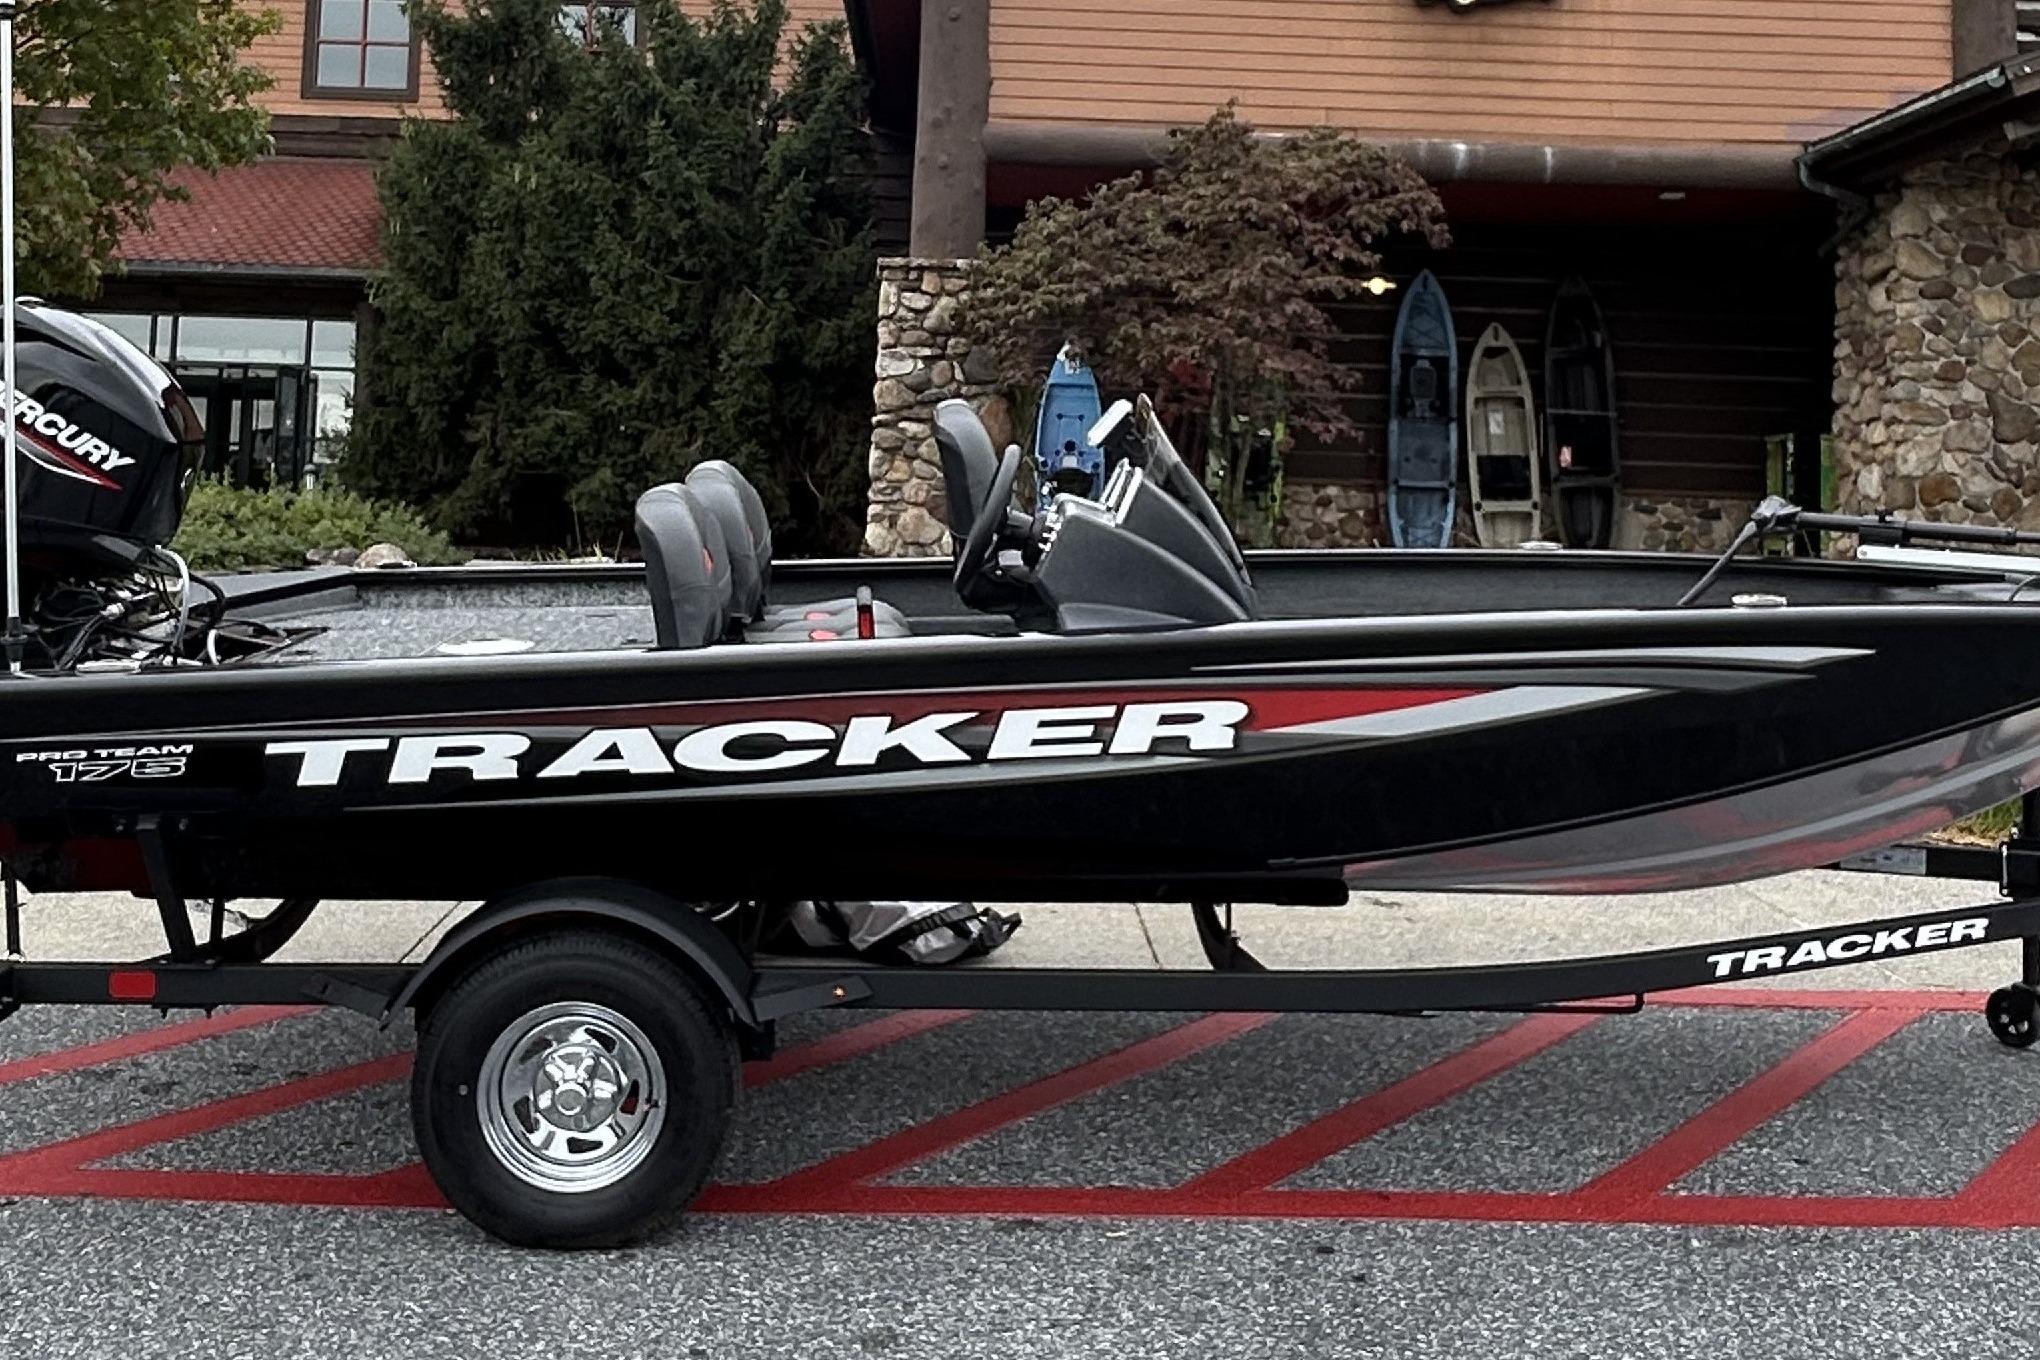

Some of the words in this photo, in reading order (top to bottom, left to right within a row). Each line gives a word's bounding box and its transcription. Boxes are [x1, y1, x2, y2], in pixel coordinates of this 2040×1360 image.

[0, 381, 136, 471] RCURY
[16, 750, 88, 762] PRO
[94, 744, 194, 757] TEAM
[49, 756, 187, 782] 175
[264, 700, 1250, 787] TRACKER
[1706, 918, 1990, 977] TRACKER
